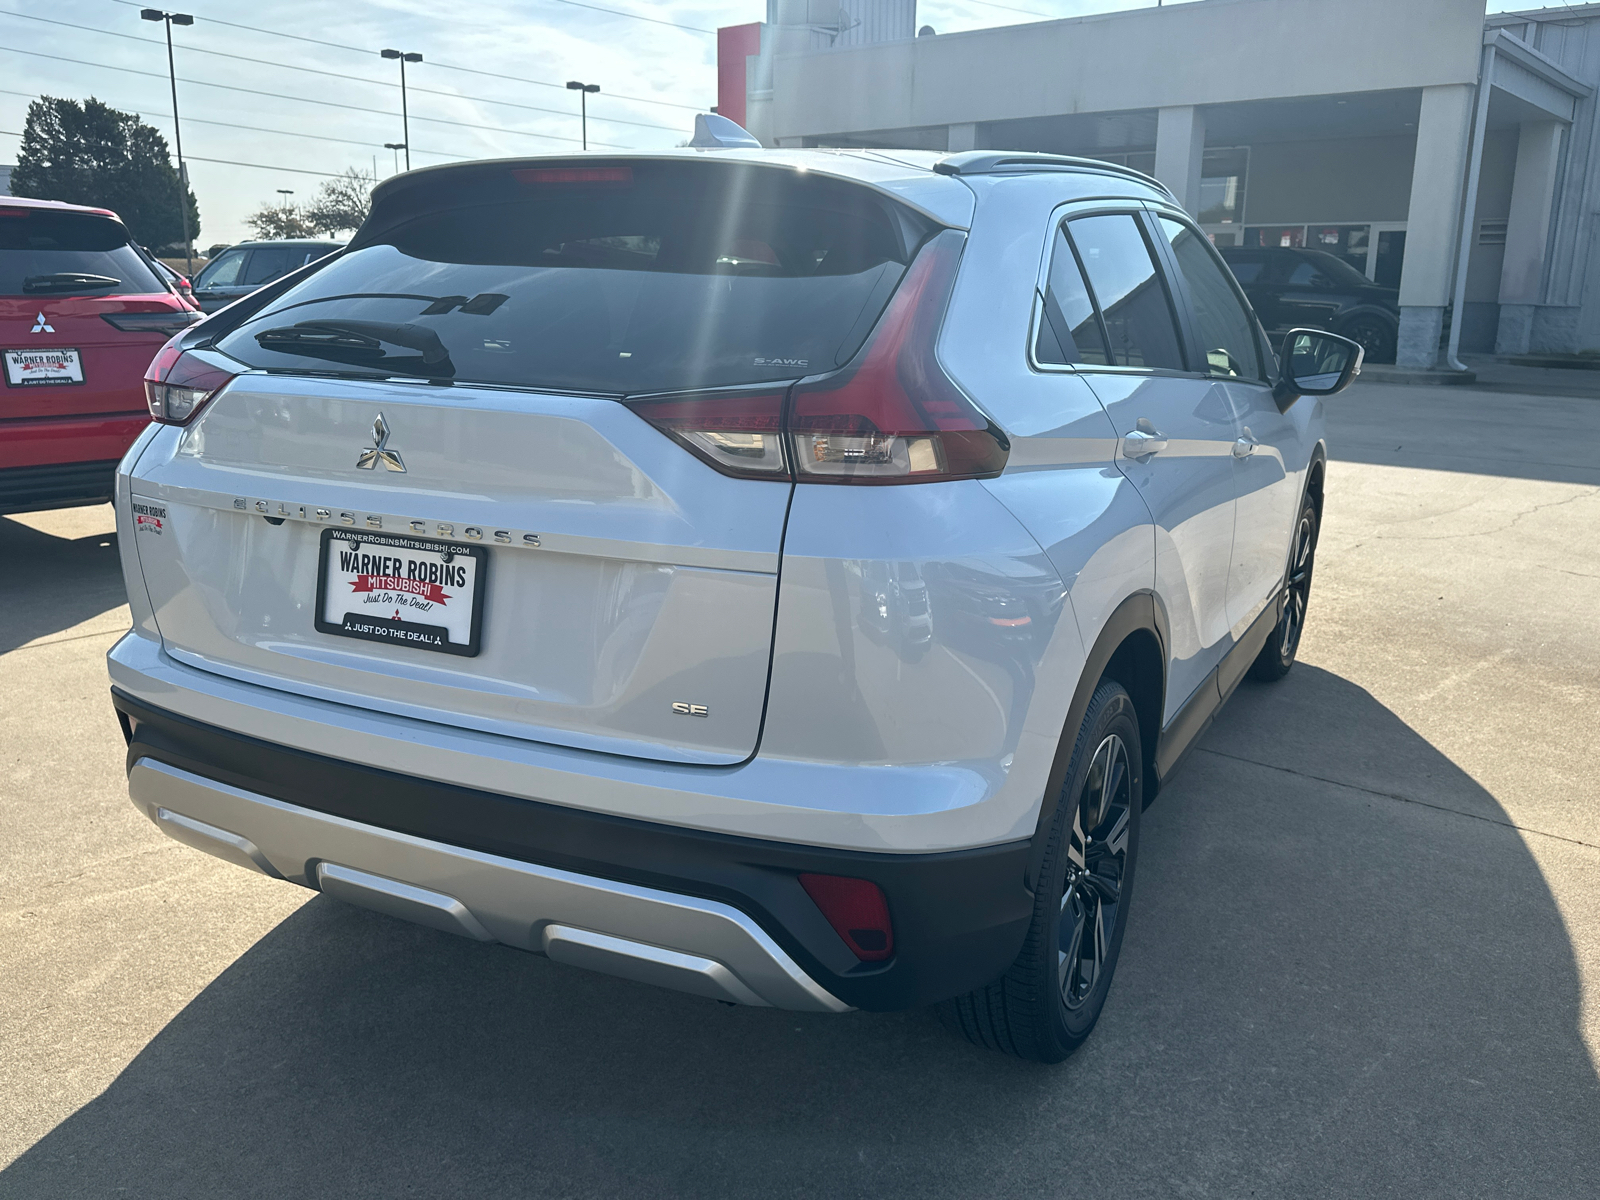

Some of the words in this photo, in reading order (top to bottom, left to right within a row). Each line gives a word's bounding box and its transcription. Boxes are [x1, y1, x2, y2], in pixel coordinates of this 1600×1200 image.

[12, 356, 44, 364] WARNER
[46, 355, 74, 363] ROBINS
[233, 497, 382, 528] ECLIPSE
[409, 520, 542, 548] CROSS
[340, 550, 402, 577] WARNER
[408, 560, 466, 588] ROBINS
[368, 577, 431, 596] MITSUBISHI
[363, 593, 380, 604] Just
[381, 593, 392, 603] Do
[396, 594, 408, 606] The
[409, 599, 434, 612] Deal!
[352, 624, 374, 634] JUST
[375, 627, 388, 635] DO
[389, 629, 406, 638] THE
[408, 632, 433, 643] DEAL!
[672, 702, 708, 716] SE
